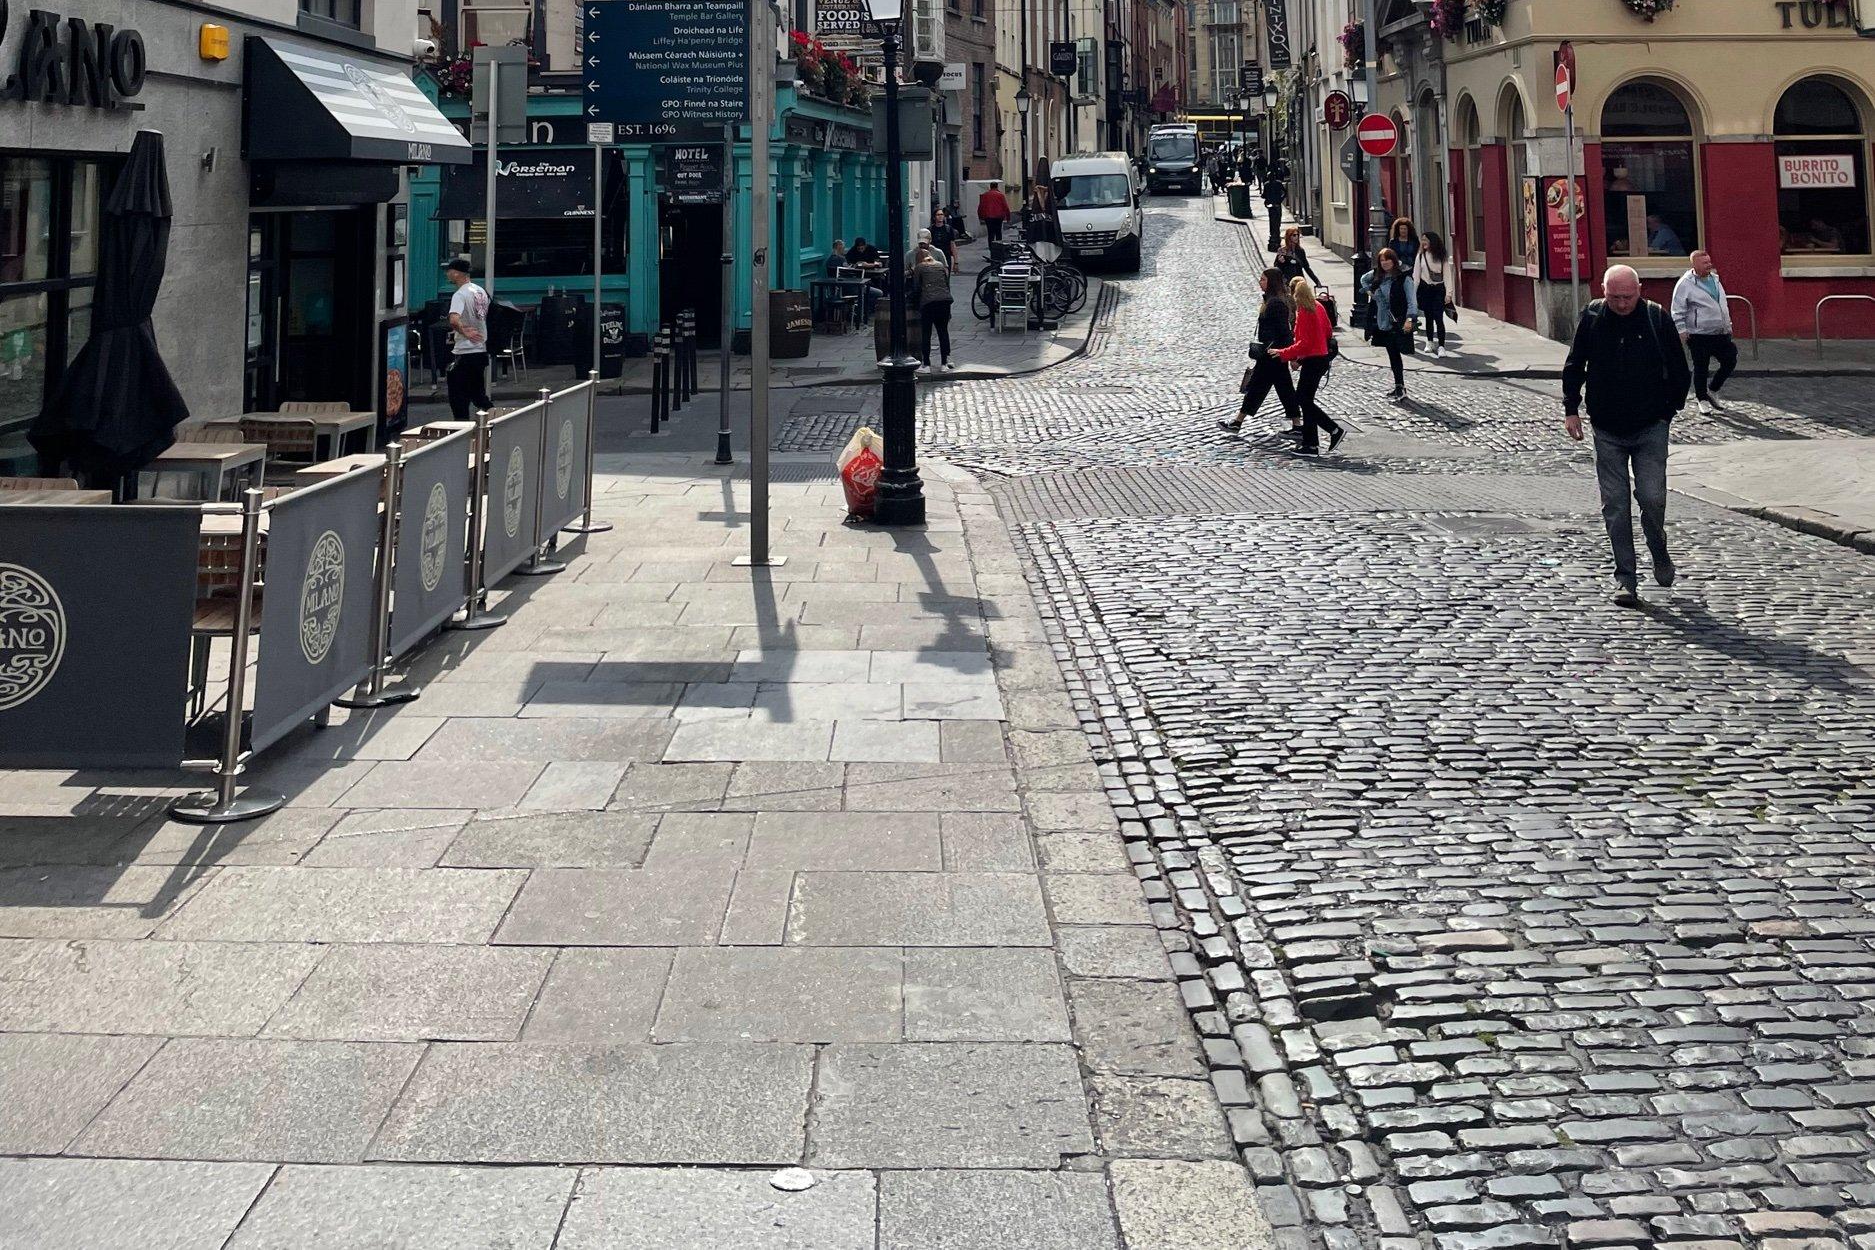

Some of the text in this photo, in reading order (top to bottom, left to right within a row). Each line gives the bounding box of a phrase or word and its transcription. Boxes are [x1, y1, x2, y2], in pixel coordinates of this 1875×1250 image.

[664, 2, 691, 10] Bharra
[705, 2, 744, 11] Teampaill
[669, 13, 698, 21] Temple
[715, 13, 744, 21] Gallery
[817, 10, 860, 21] FOOD
[817, 21, 860, 30] SERVED
[673, 26, 714, 35] Droichead
[728, 26, 744, 34] Life
[653, 37, 744, 46] Liffey Ha'penny Bridge
[628, 51, 663, 59] Músaem
[665, 51, 697, 59] Céarach
[635, 62, 670, 70] National
[691, 61, 726, 69] Museum
[728, 61, 744, 69] Plus
[659, 75, 692, 84] Coláiste
[686, 85, 744, 94] Trinity College
[684, 100, 706, 108] Finné
[720, 100, 744, 108] Staire
[682, 110, 713, 118] Witness
[715, 110, 744, 119] History
[618, 124, 644, 135] EST.
[649, 124, 676, 135] 1696
[407, 143, 432, 161] MILANO
[675, 148, 709, 160] HOTEL
[1784, 159, 1839, 172] BURRITO
[1790, 172, 1848, 185] BONITO
[304, 582, 340, 616] MILANO
